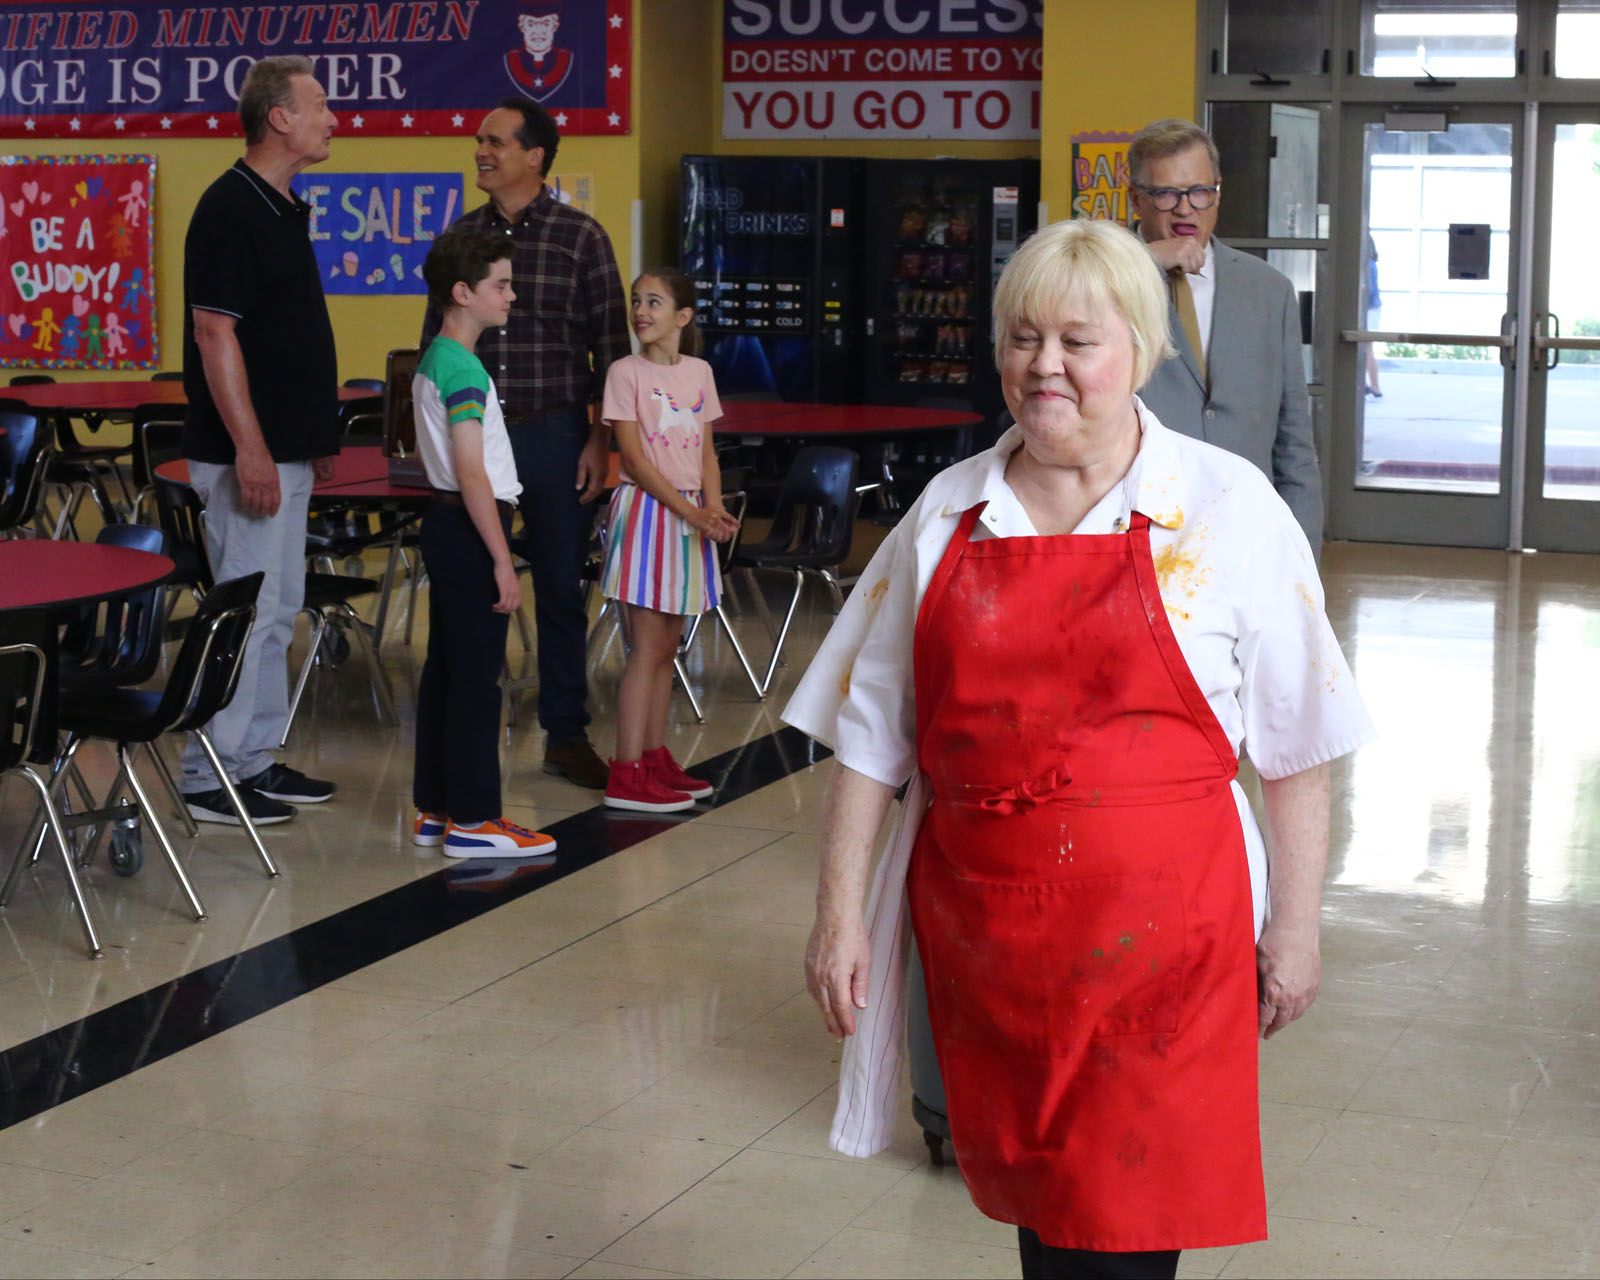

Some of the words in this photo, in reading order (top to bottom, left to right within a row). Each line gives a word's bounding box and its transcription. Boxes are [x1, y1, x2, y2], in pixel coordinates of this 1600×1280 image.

[0, 10, 138, 50] IFIED
[151, 1, 479, 48] MINUTEMEN
[730, 0, 1043, 35] SUCCES
[0, 59, 87, 105] GE
[106, 56, 161, 103] IS
[184, 53, 406, 103] POER
[731, 49, 856, 73] DOESN'T
[864, 48, 953, 72] COME
[962, 48, 1002, 71] TO
[732, 91, 835, 129] YOU
[853, 90, 926, 129] GO
[944, 90, 1011, 129] TO
[30, 216, 65, 254] BE
[76, 217, 95, 251] A
[725, 211, 810, 234] DRINKS
[11, 261, 121, 304] BUDDY!
[775, 317, 802, 327] COLD
